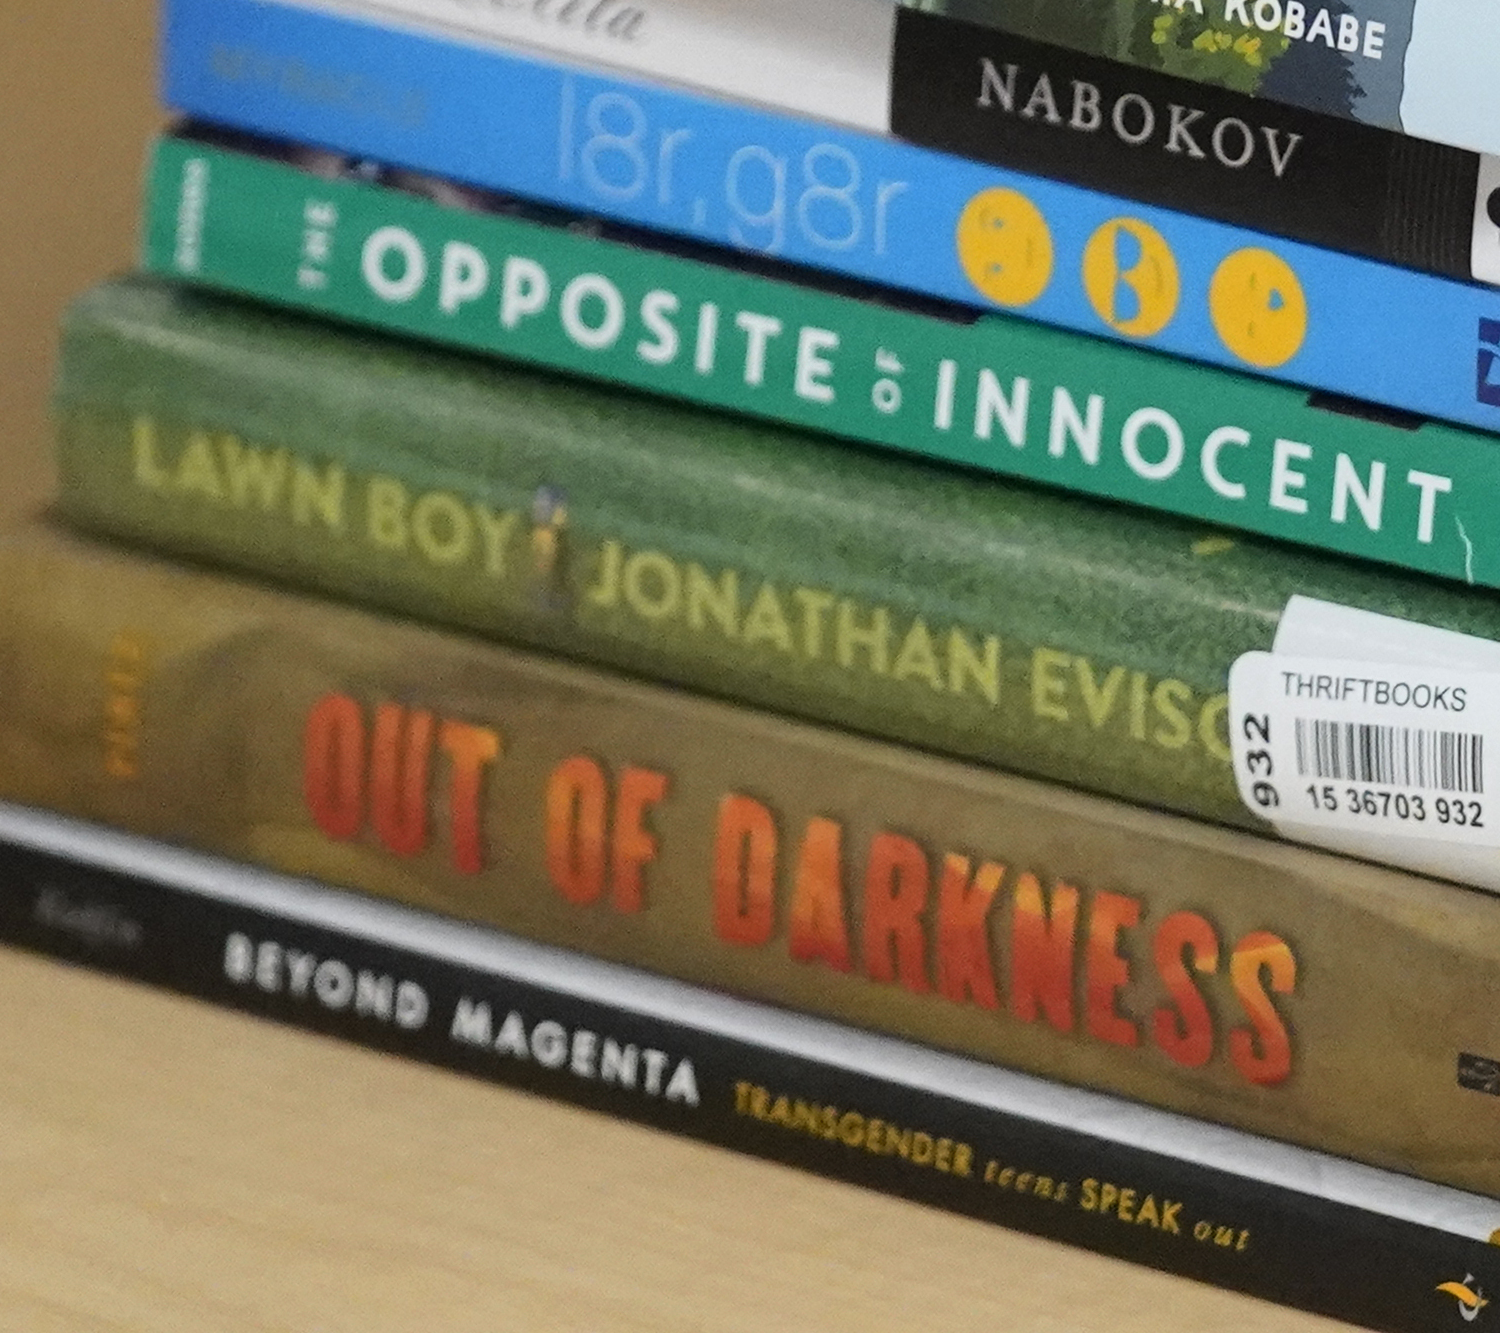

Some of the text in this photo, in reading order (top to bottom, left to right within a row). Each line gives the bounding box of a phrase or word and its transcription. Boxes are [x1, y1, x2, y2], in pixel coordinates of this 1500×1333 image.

[976, 56, 1304, 178] NABOKOV
[360, 225, 842, 405] OPPOSITE
[871, 344, 905, 415] OF
[934, 358, 1453, 544] INNOCENT
[132, 414, 347, 530] LAWN
[366, 473, 521, 579] BOY
[588, 540, 1001, 704] JONATHAN
[1243, 713, 1280, 808] 932
[1281, 671, 1468, 713] THRIFTBOOKS
[304, 691, 501, 876] OUT
[545, 756, 671, 916] OF
[712, 792, 1297, 1087] DARKNESS
[1306, 783, 1485, 829] 15 36703 932
[223, 931, 1251, 1253] BEYOND MAGENTA TRANSGENDER teens SPEAK out
